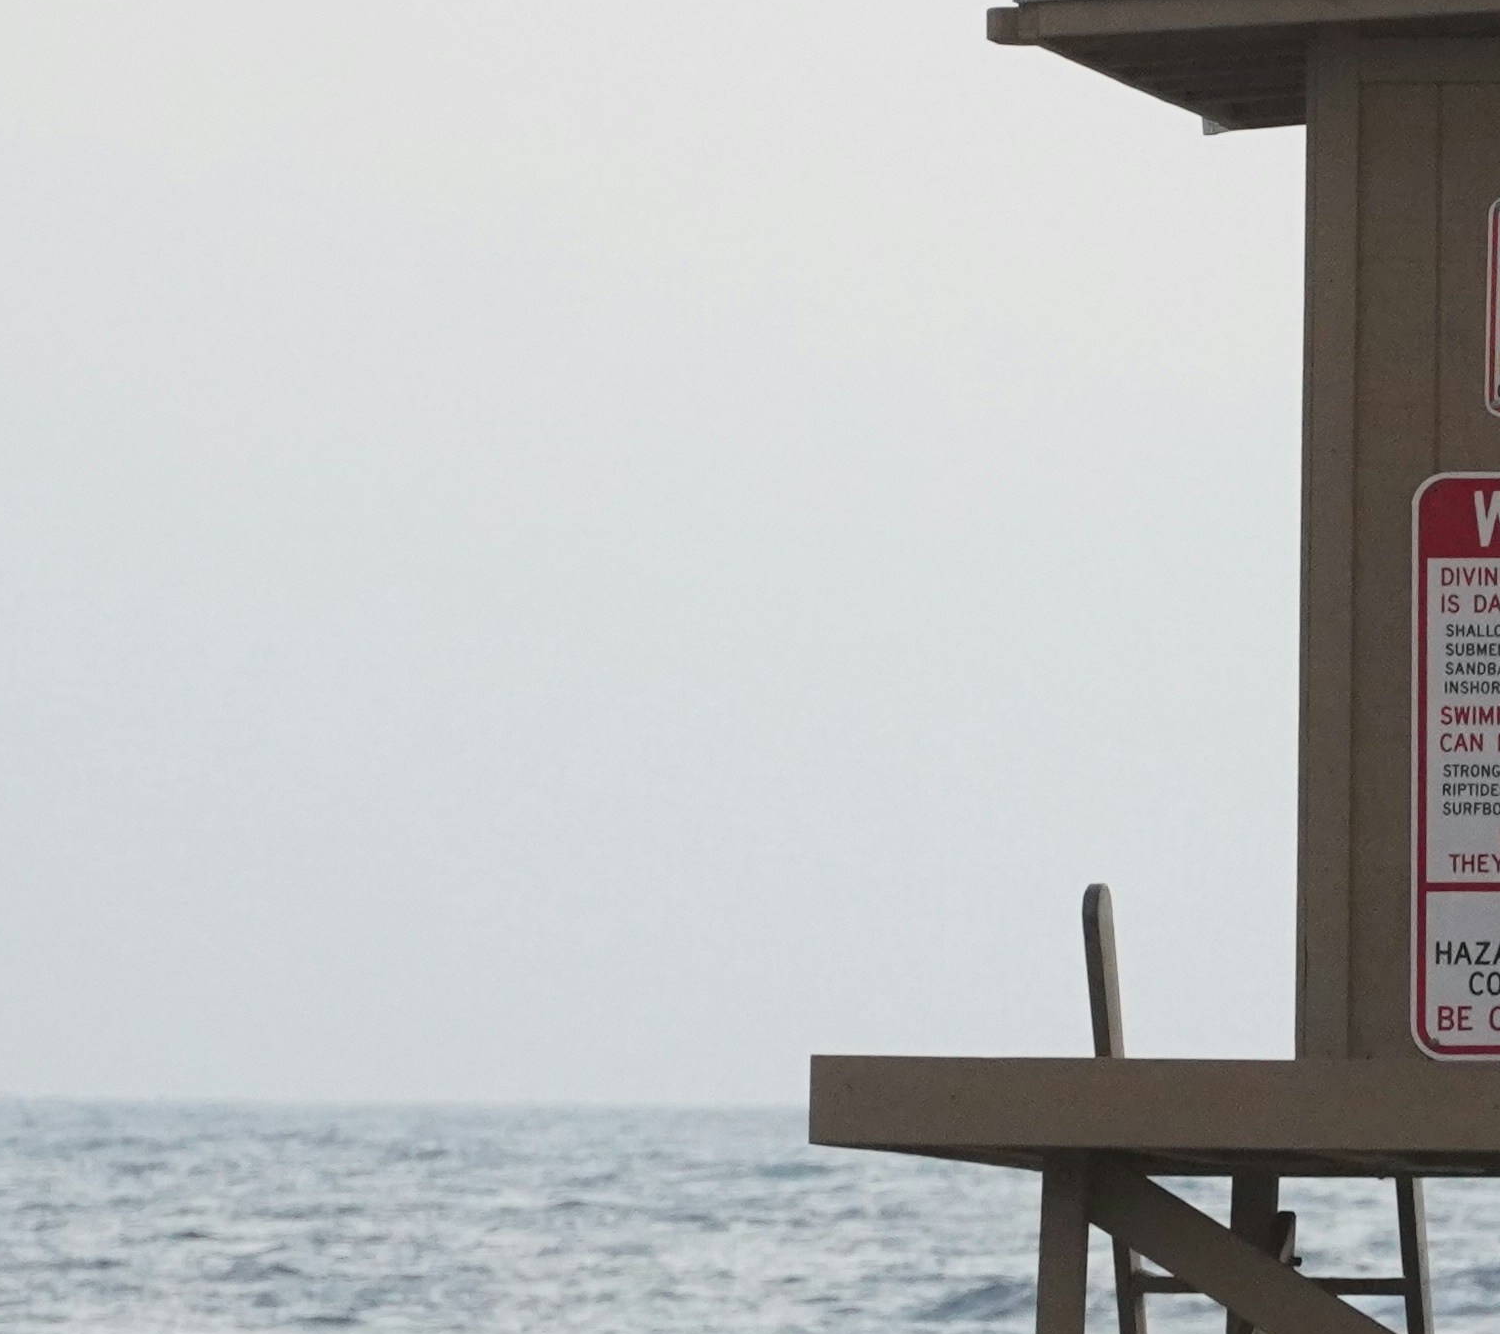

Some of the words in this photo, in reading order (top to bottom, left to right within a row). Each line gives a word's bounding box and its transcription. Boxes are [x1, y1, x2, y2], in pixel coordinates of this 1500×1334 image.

[1441, 594, 1460, 613] IS
[1440, 733, 1483, 752] CAN
[1443, 764, 1500, 778] STRONG
[1437, 1006, 1472, 1031] BE
